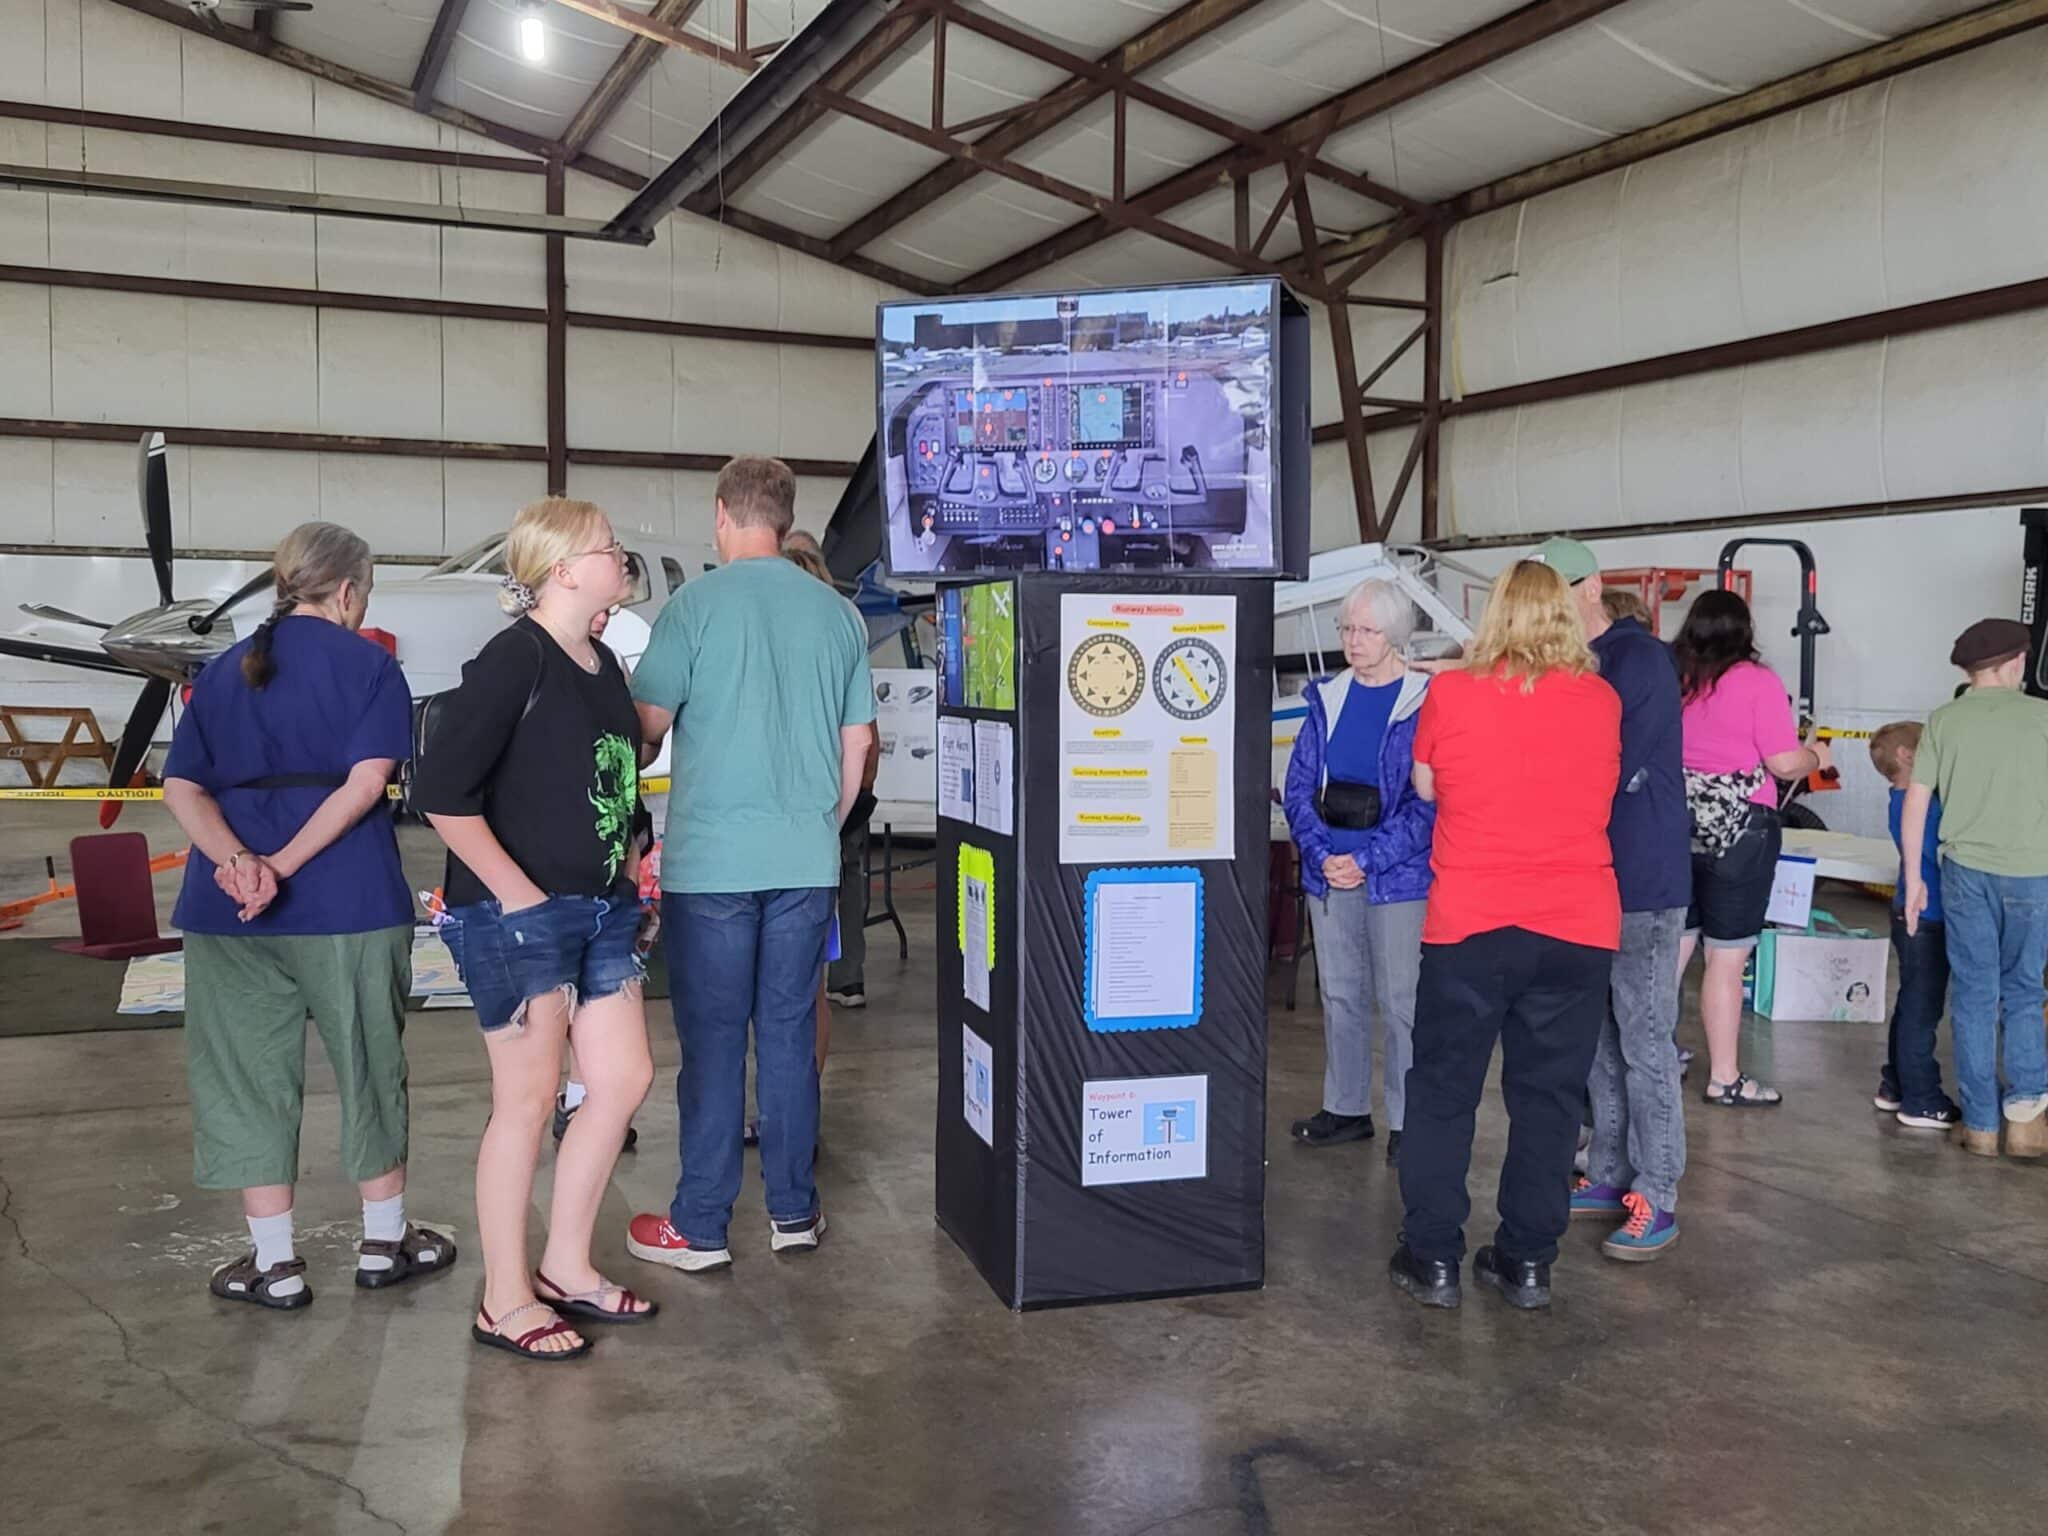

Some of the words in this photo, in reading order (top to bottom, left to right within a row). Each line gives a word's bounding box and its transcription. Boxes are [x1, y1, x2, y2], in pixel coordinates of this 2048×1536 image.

[2023, 566, 2038, 625] CLARK
[96, 790, 154, 798] CAUTION
[1088, 1108, 1132, 1120] Tower
[1088, 1128, 1104, 1143] of
[1088, 1148, 1172, 1164] Information
